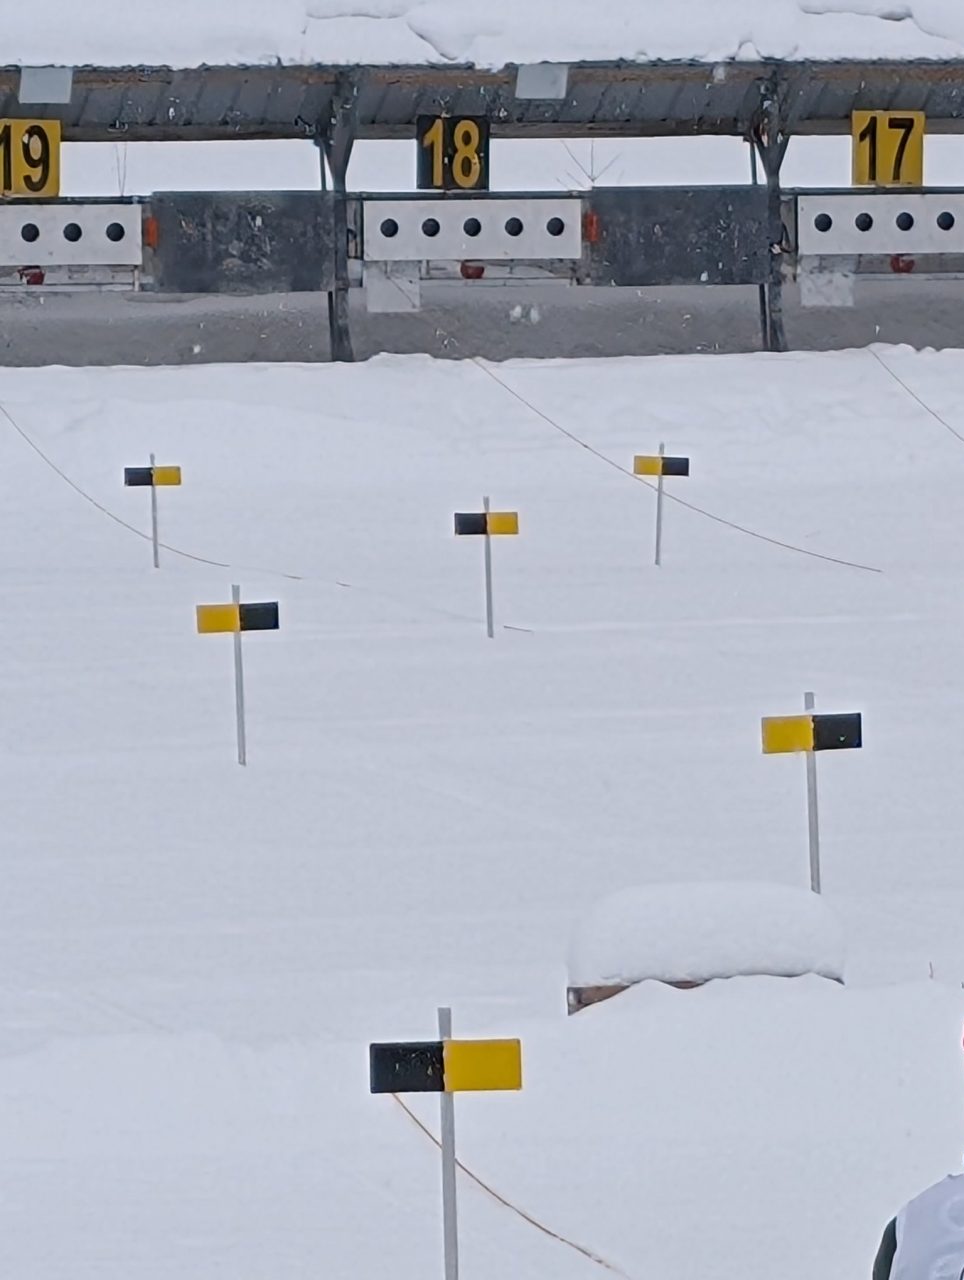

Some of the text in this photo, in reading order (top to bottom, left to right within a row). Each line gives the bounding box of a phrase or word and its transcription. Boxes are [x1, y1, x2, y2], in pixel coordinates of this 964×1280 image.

[0, 124, 50, 192] 19
[422, 120, 480, 188] 18
[859, 116, 914, 181] 17
